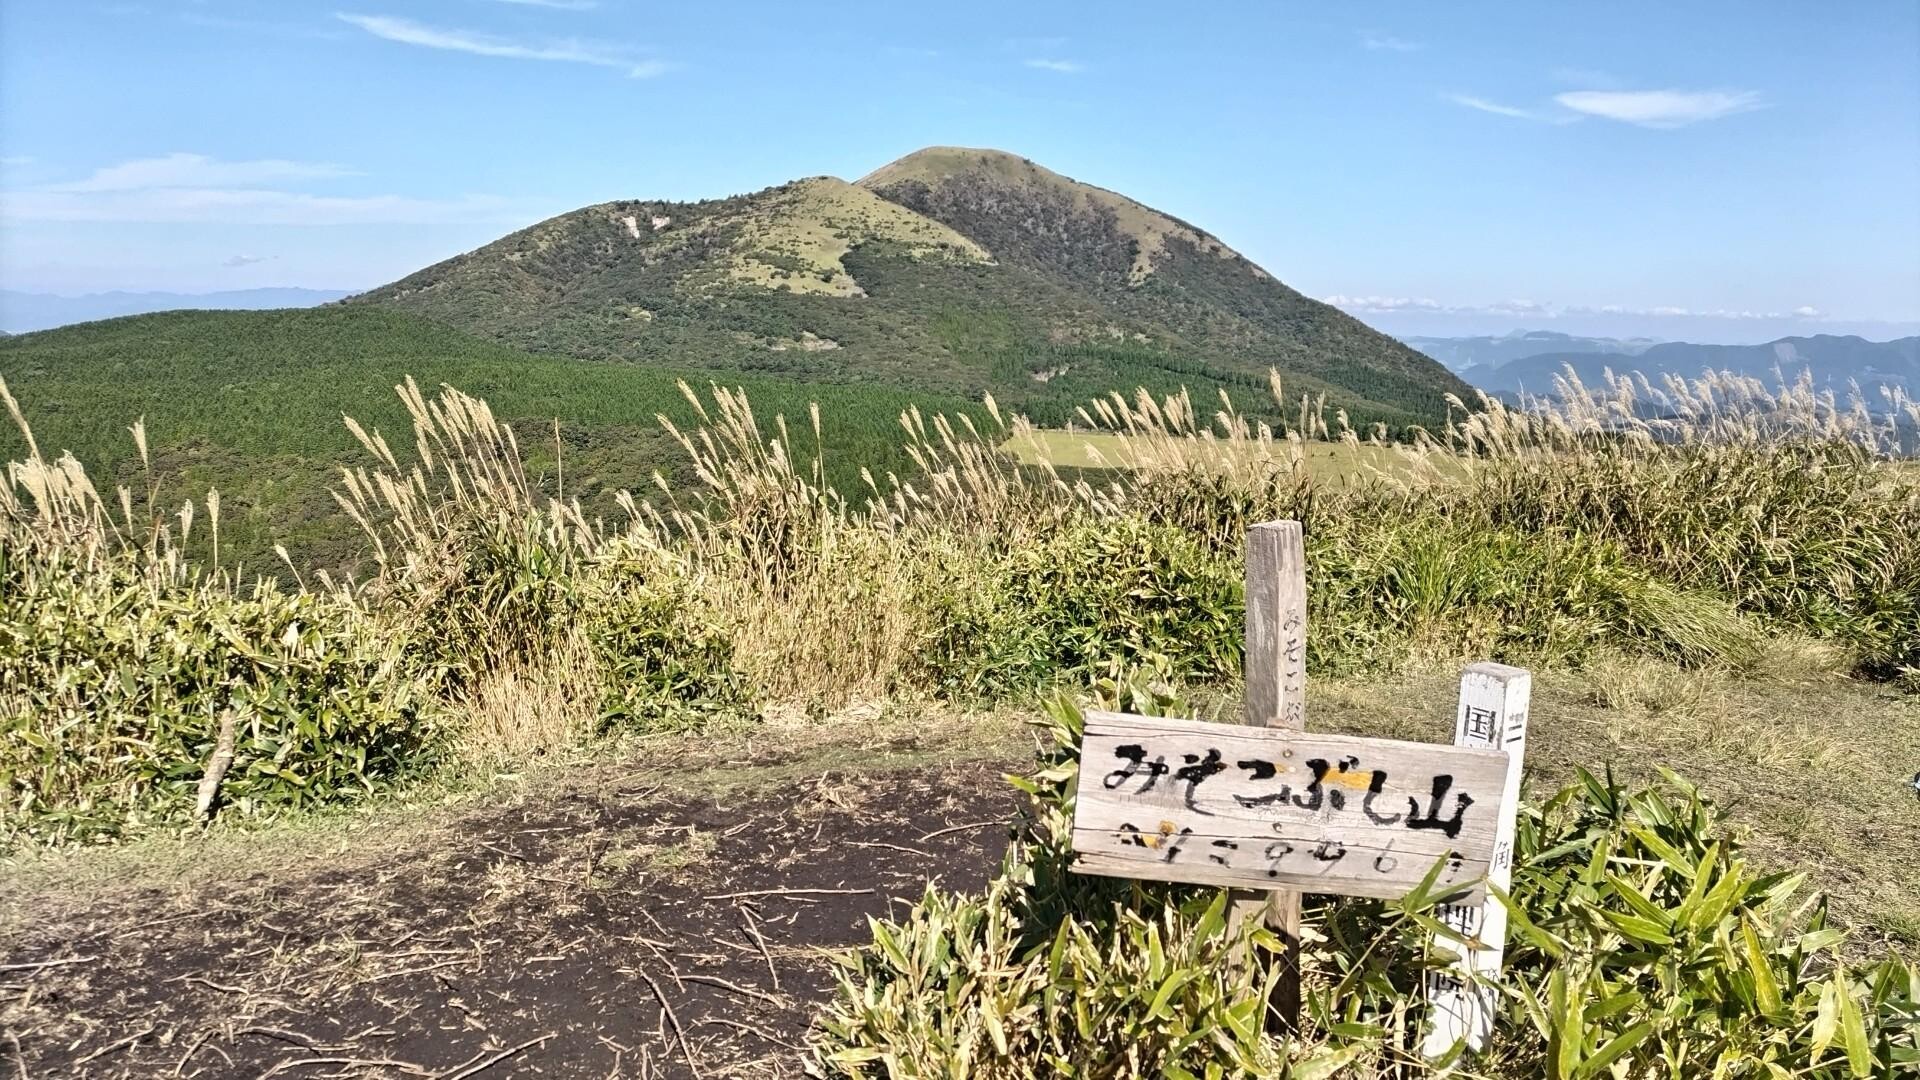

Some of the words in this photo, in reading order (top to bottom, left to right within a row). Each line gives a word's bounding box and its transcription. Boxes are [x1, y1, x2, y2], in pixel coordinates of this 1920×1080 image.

[1103, 744, 1475, 839] みそこぶし山
